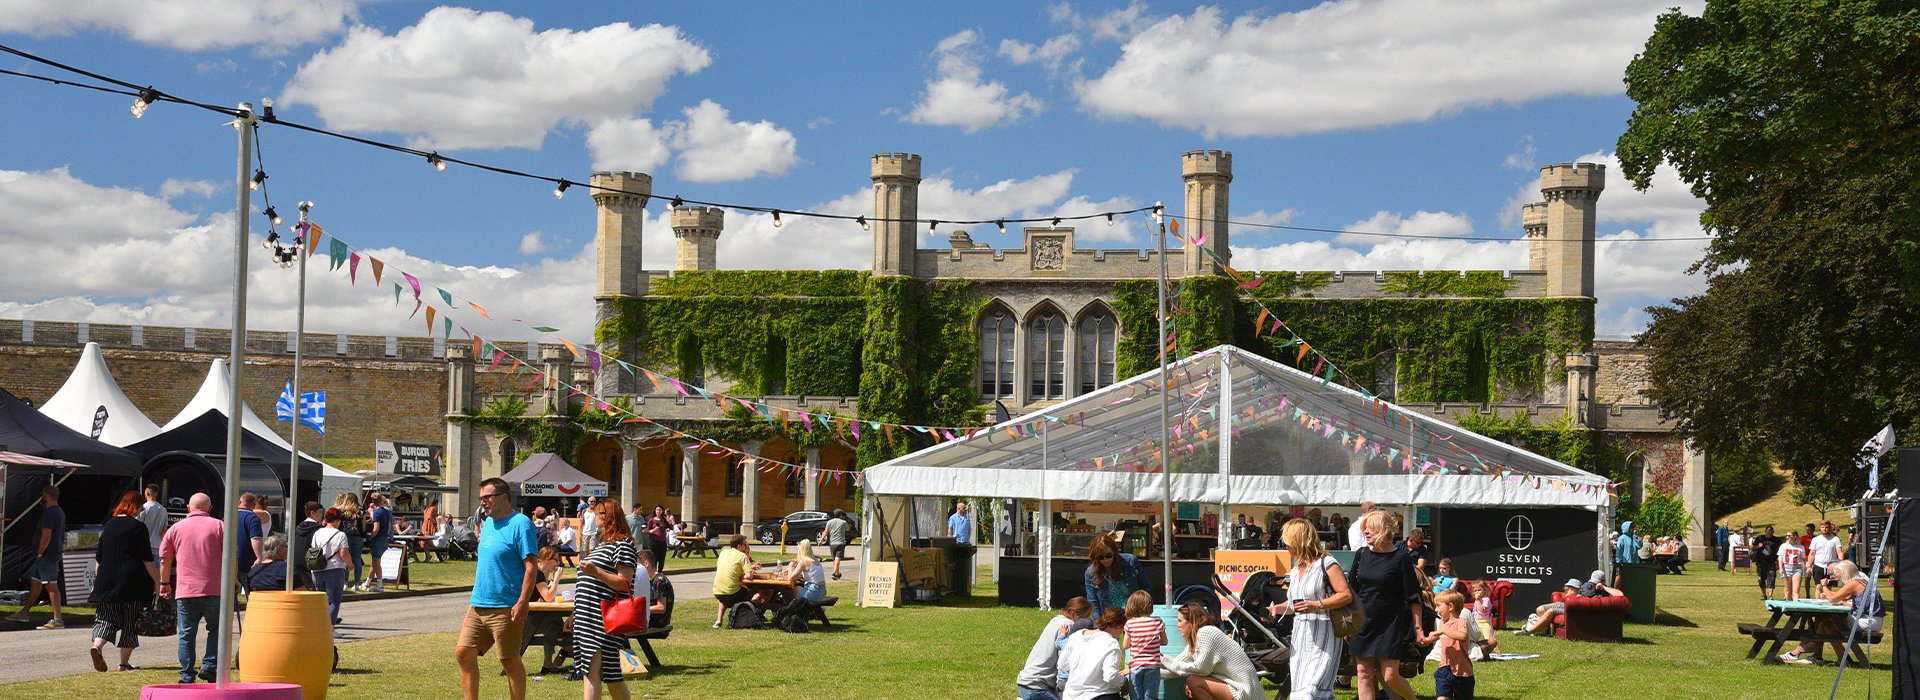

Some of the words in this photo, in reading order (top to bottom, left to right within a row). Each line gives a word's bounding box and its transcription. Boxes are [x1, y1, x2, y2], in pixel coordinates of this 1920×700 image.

[401, 446, 430, 457] BURGER
[401, 457, 431, 473] FRIES
[1499, 553, 1540, 563] SEVEN
[1218, 565, 1242, 573] PICNIC
[1486, 565, 1553, 576] DISTRICTS
